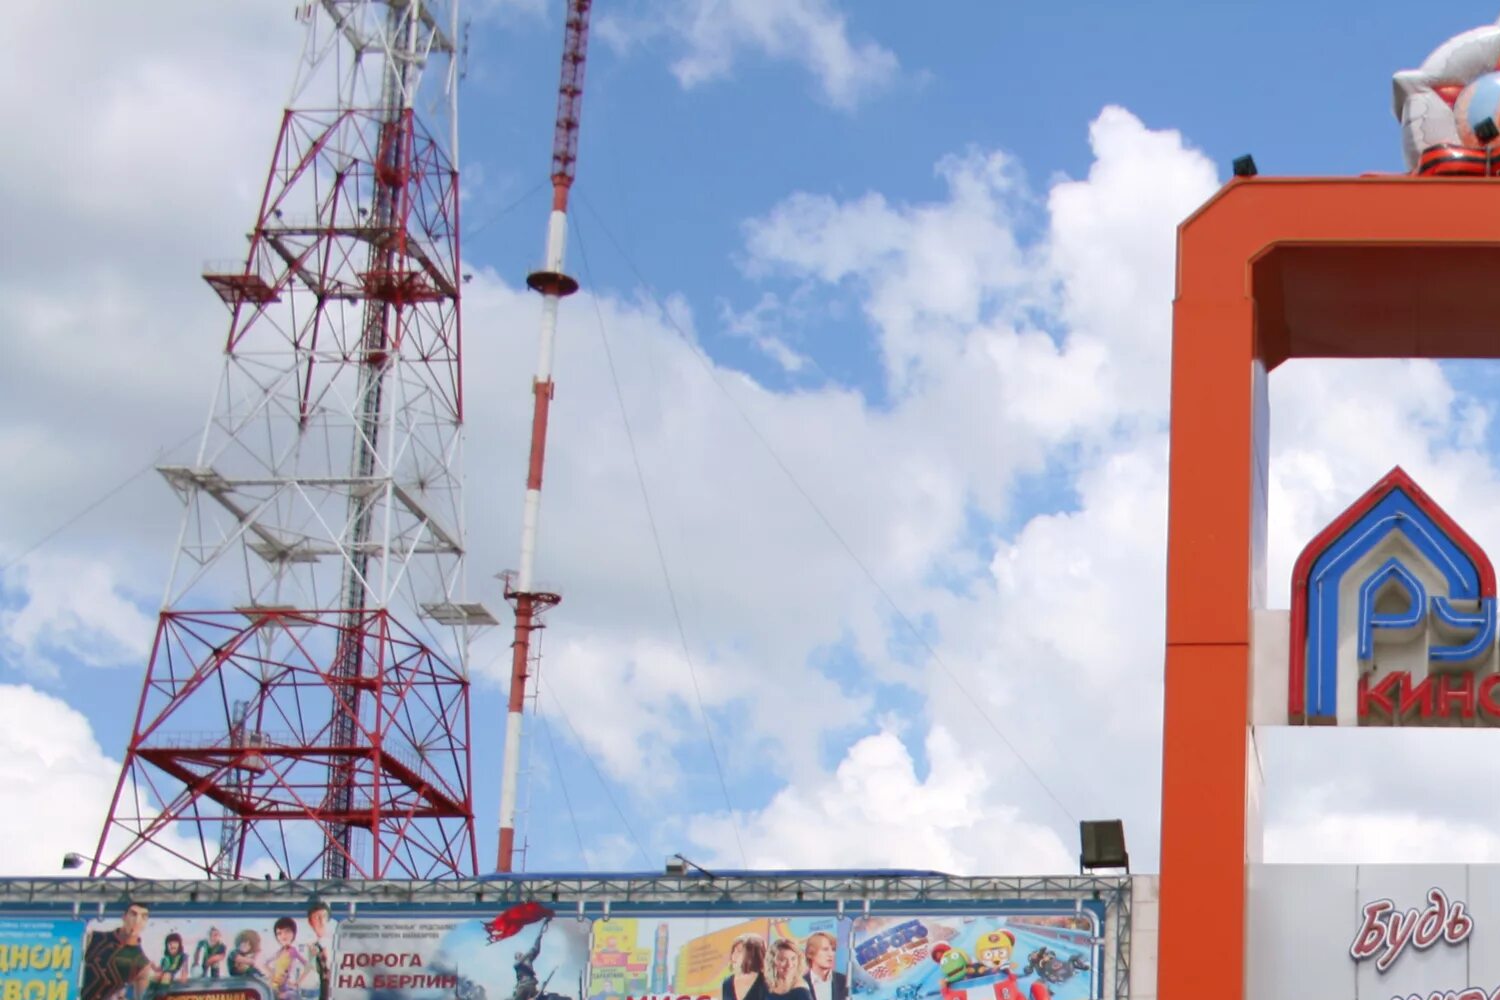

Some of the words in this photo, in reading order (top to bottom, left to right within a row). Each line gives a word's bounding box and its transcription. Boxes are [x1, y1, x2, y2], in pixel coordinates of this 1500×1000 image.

[1350, 888, 1473, 972] Будь
[340, 952, 422, 970] ДОРОГА
[338, 974, 366, 989] НА
[373, 974, 457, 990] БЕРЛИН
